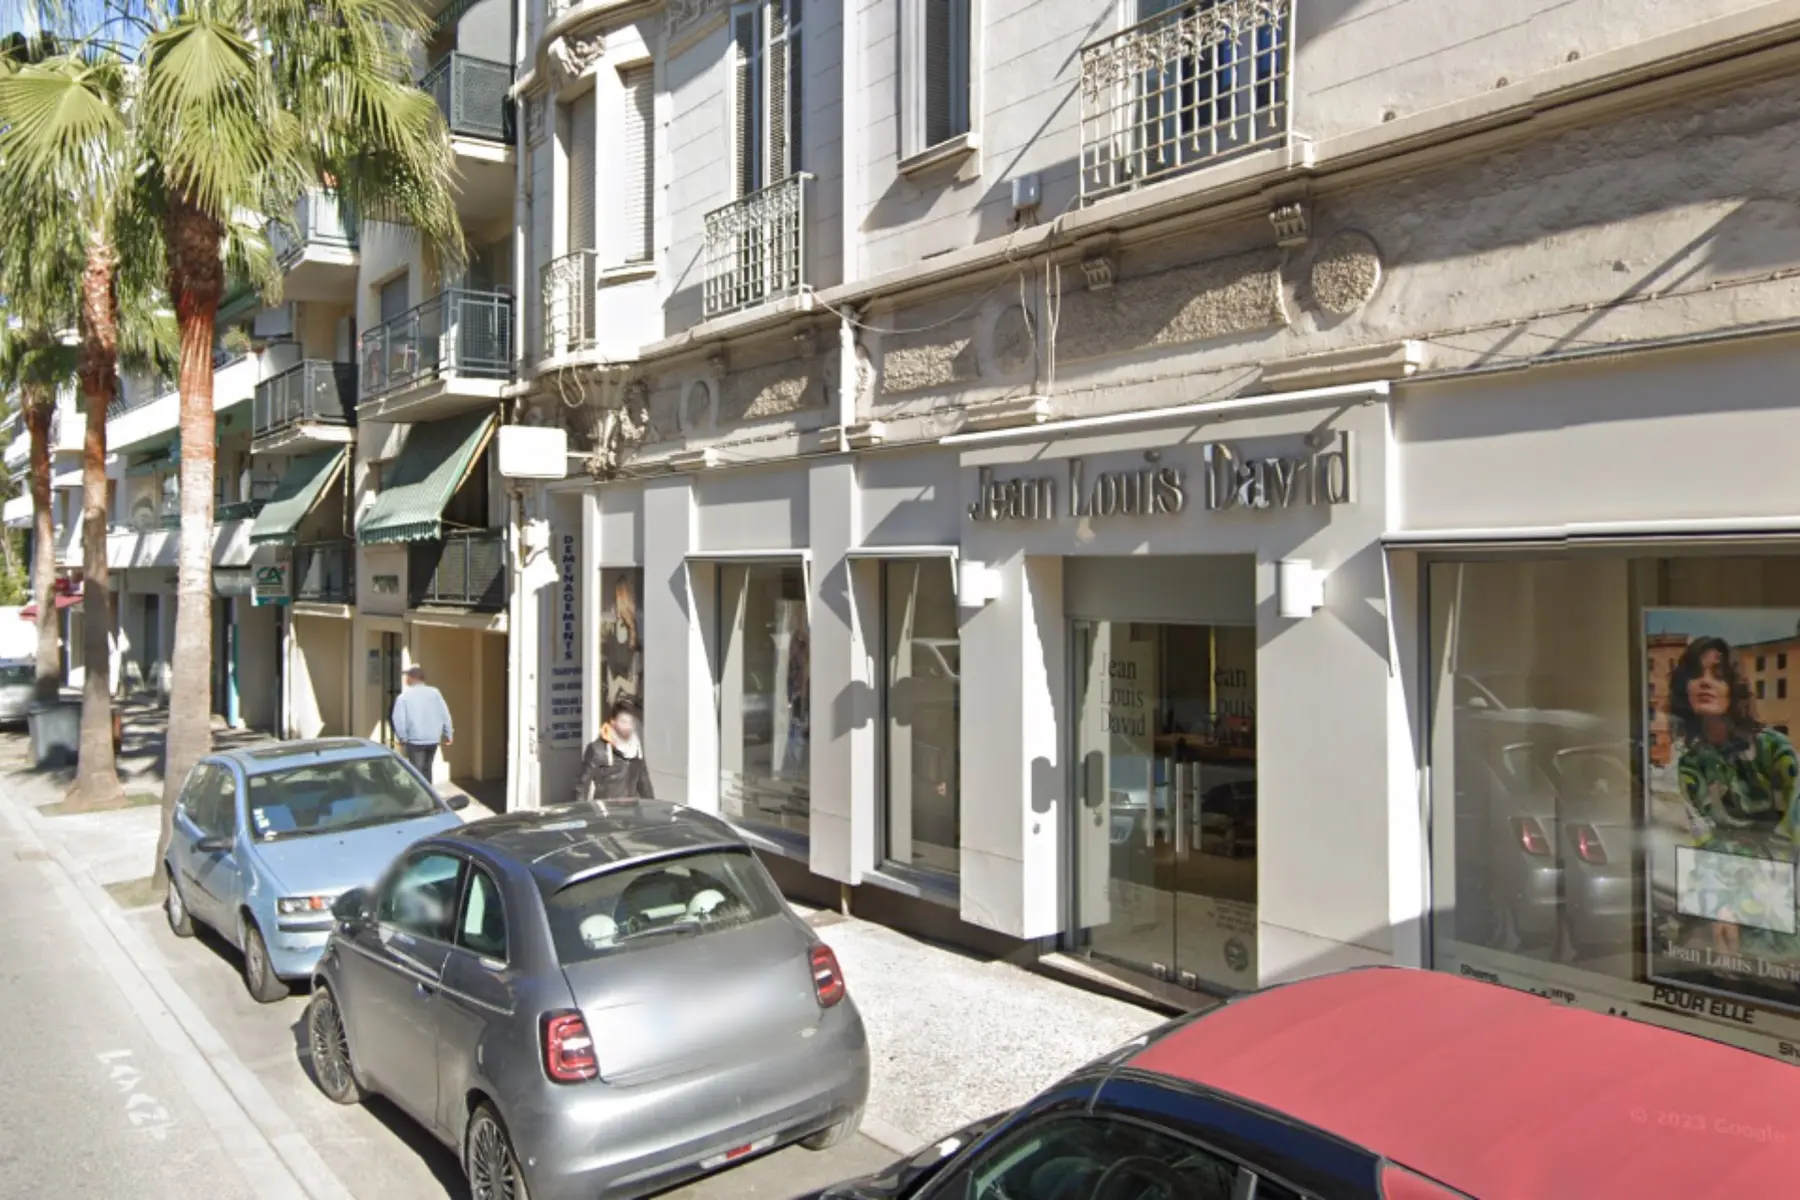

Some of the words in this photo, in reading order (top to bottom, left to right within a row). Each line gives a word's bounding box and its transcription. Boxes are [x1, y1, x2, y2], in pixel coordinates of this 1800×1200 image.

[967, 466, 1057, 522] Jean
[1068, 450, 1186, 518] Louis
[1203, 430, 1357, 512] David
[563, 535, 575, 660] DEMENAGEMENTS
[1099, 651, 1137, 680] Jean
[1100, 679, 1144, 708] Louis
[1100, 707, 1146, 737] David
[1663, 940, 1700, 964] Jean
[1706, 947, 1752, 973] Louis
[1652, 984, 1704, 1013] POUR
[1710, 1001, 1755, 1024] ELLE
